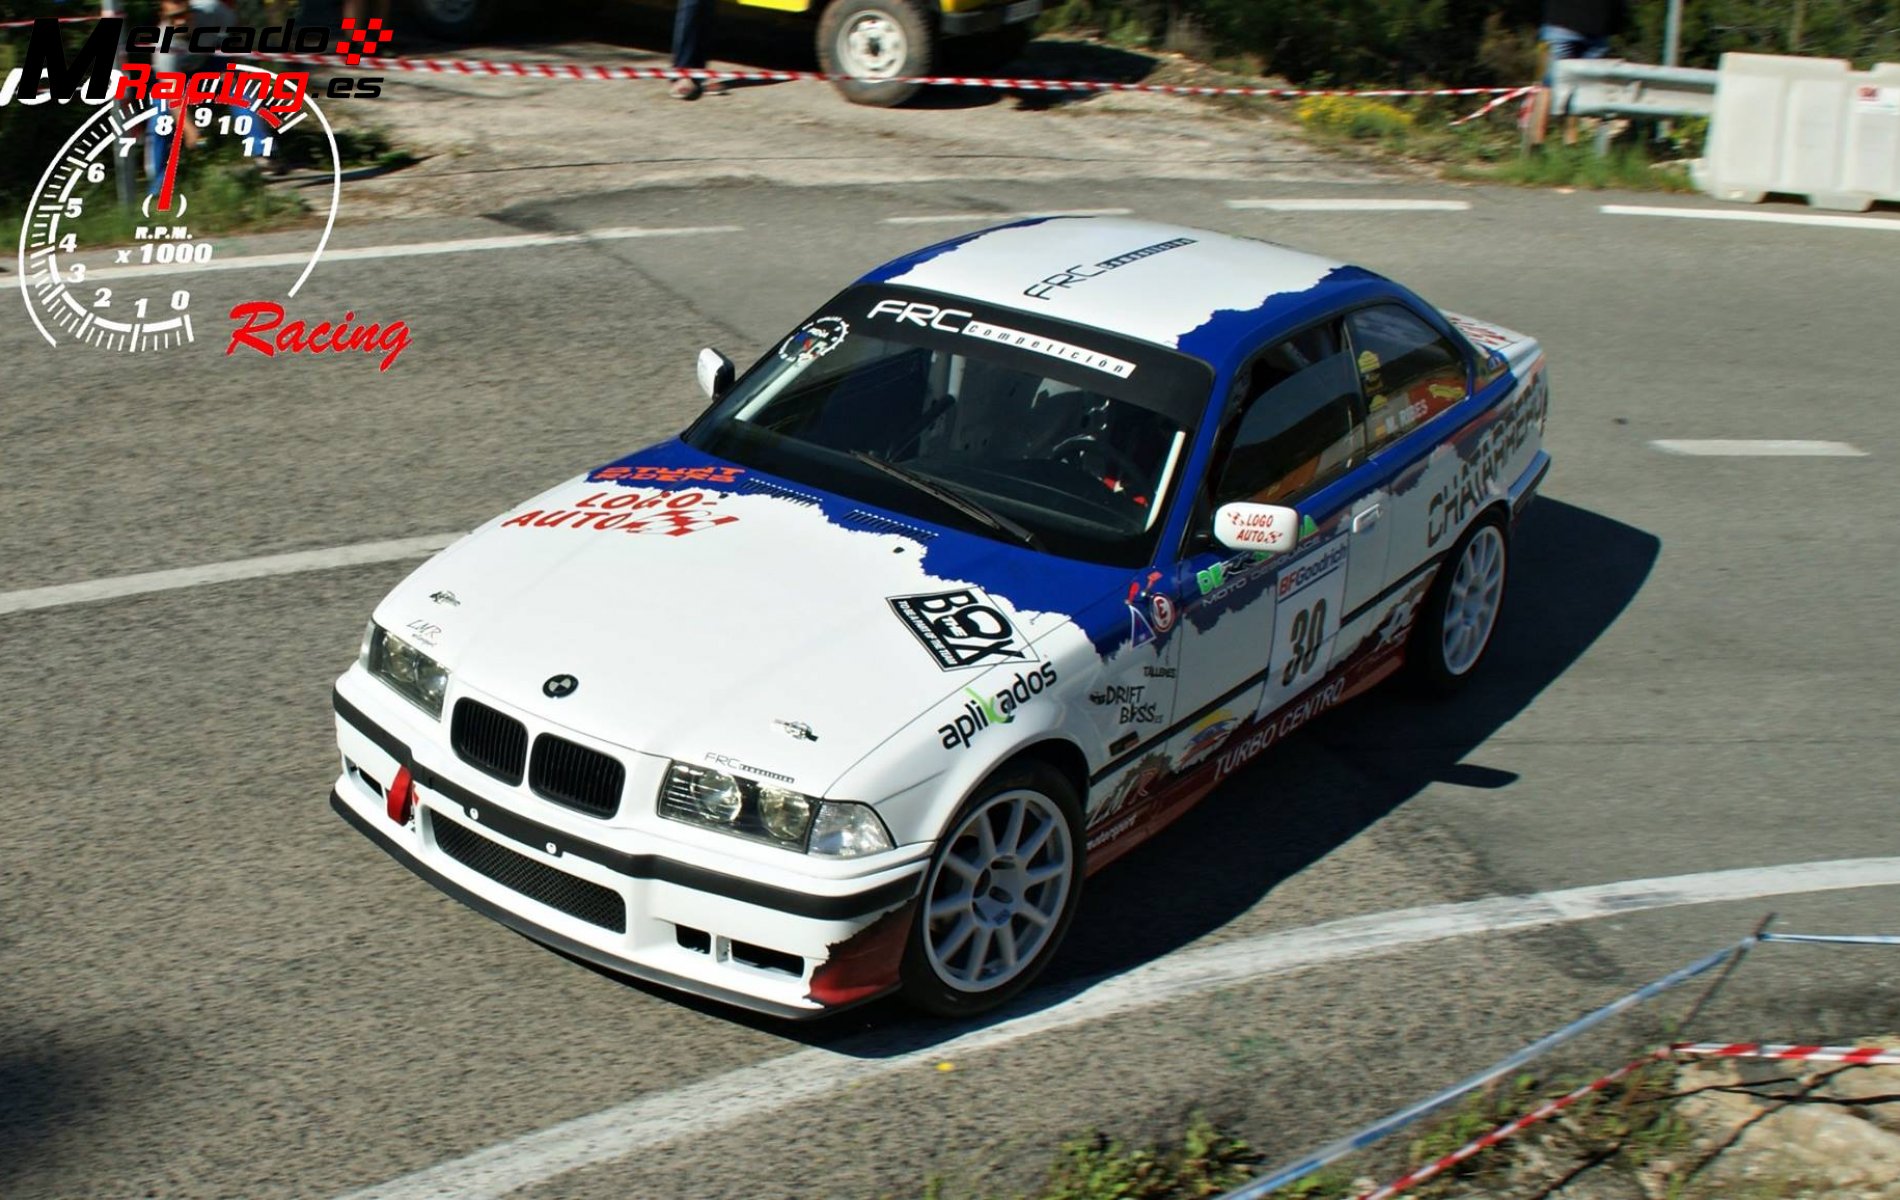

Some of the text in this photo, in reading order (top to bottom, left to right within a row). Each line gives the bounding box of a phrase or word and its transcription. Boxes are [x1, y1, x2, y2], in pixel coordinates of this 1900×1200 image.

[1023, 265, 1106, 300] FRC
[867, 300, 973, 333] FRC
[501, 510, 634, 530] AUTO
[1236, 530, 1265, 542] AUTO
[1246, 514, 1274, 527] LOGO
[1279, 543, 1347, 597] BFGoodrich
[1282, 598, 1326, 687] 30
[1106, 685, 1145, 705] DRIFT
[1213, 677, 1345, 781] TURBO CENTRO
